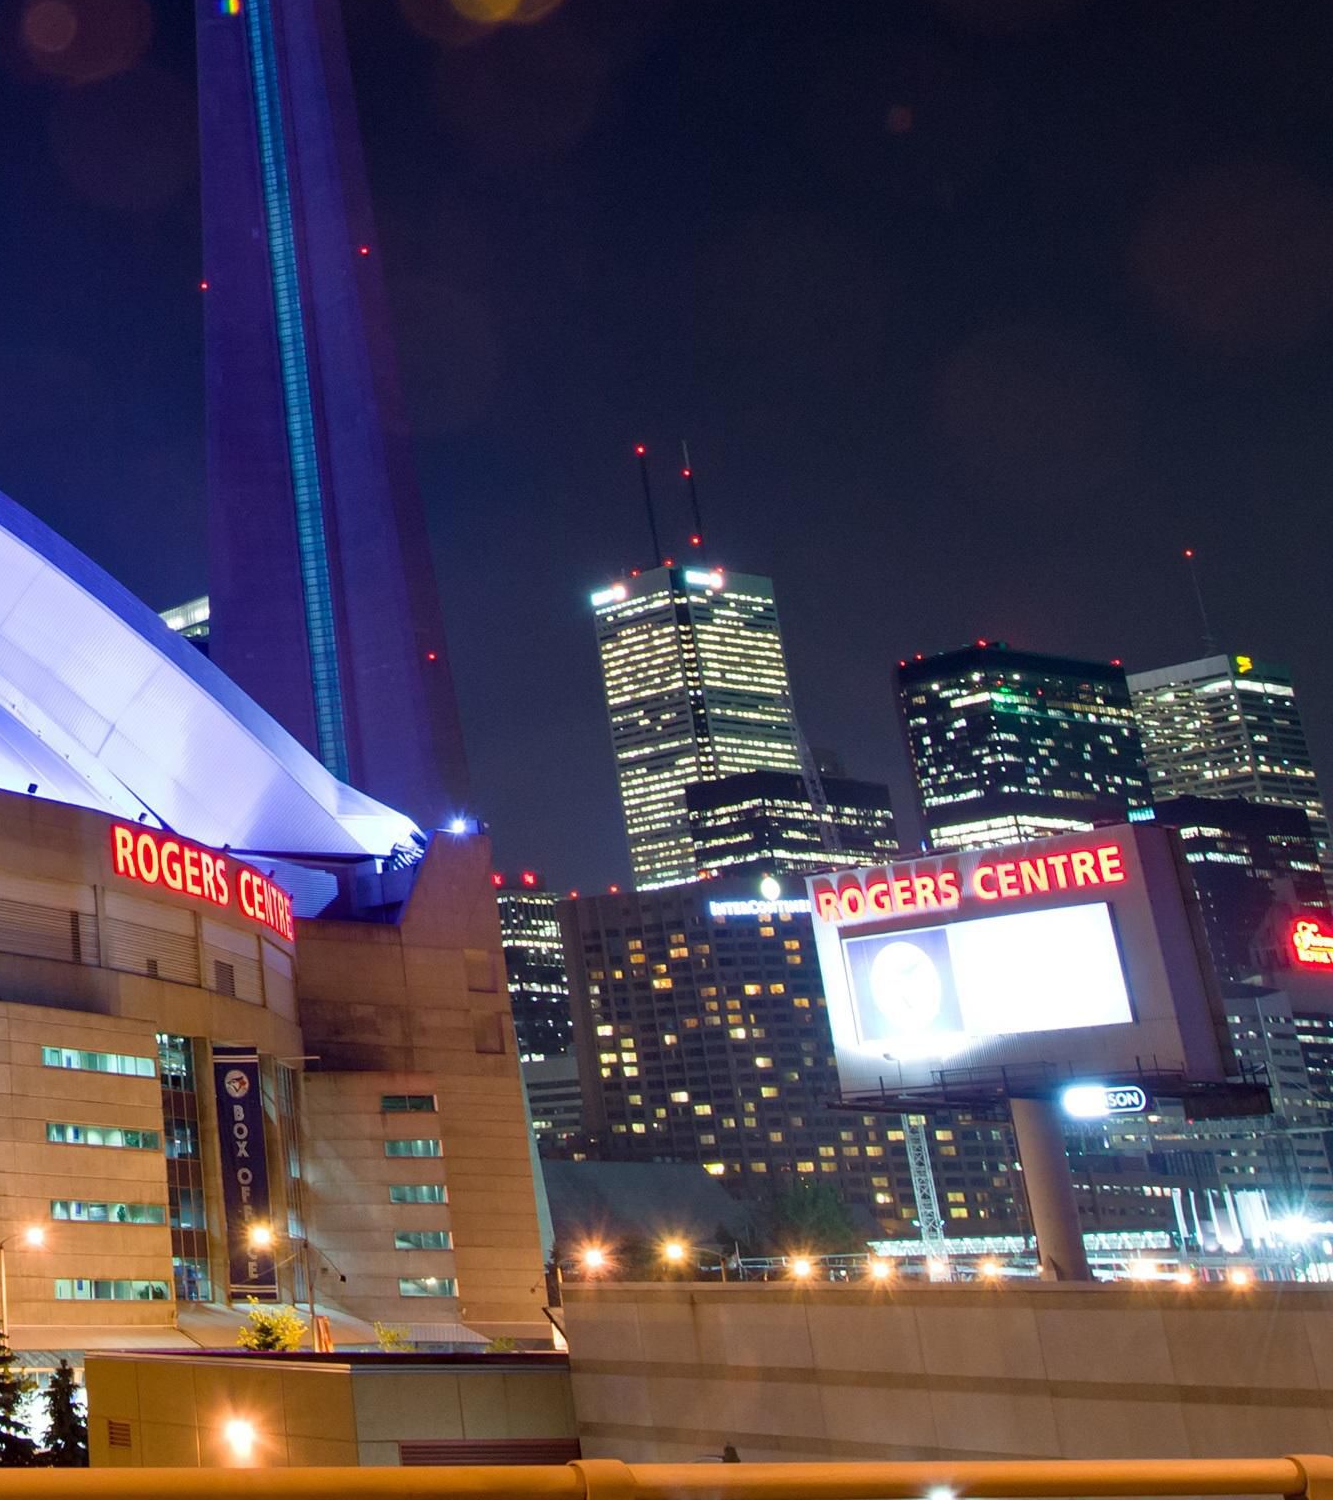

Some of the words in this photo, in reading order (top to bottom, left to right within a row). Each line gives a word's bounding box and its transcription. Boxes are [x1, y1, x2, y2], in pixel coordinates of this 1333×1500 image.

[113, 825, 230, 906] ROGERS
[239, 869, 294, 941] CENTRE
[818, 871, 961, 924] ROGERS
[972, 845, 1125, 901] CENTRE
[233, 1104, 250, 1158] BOX
[237, 1167, 259, 1279] OFFCE
